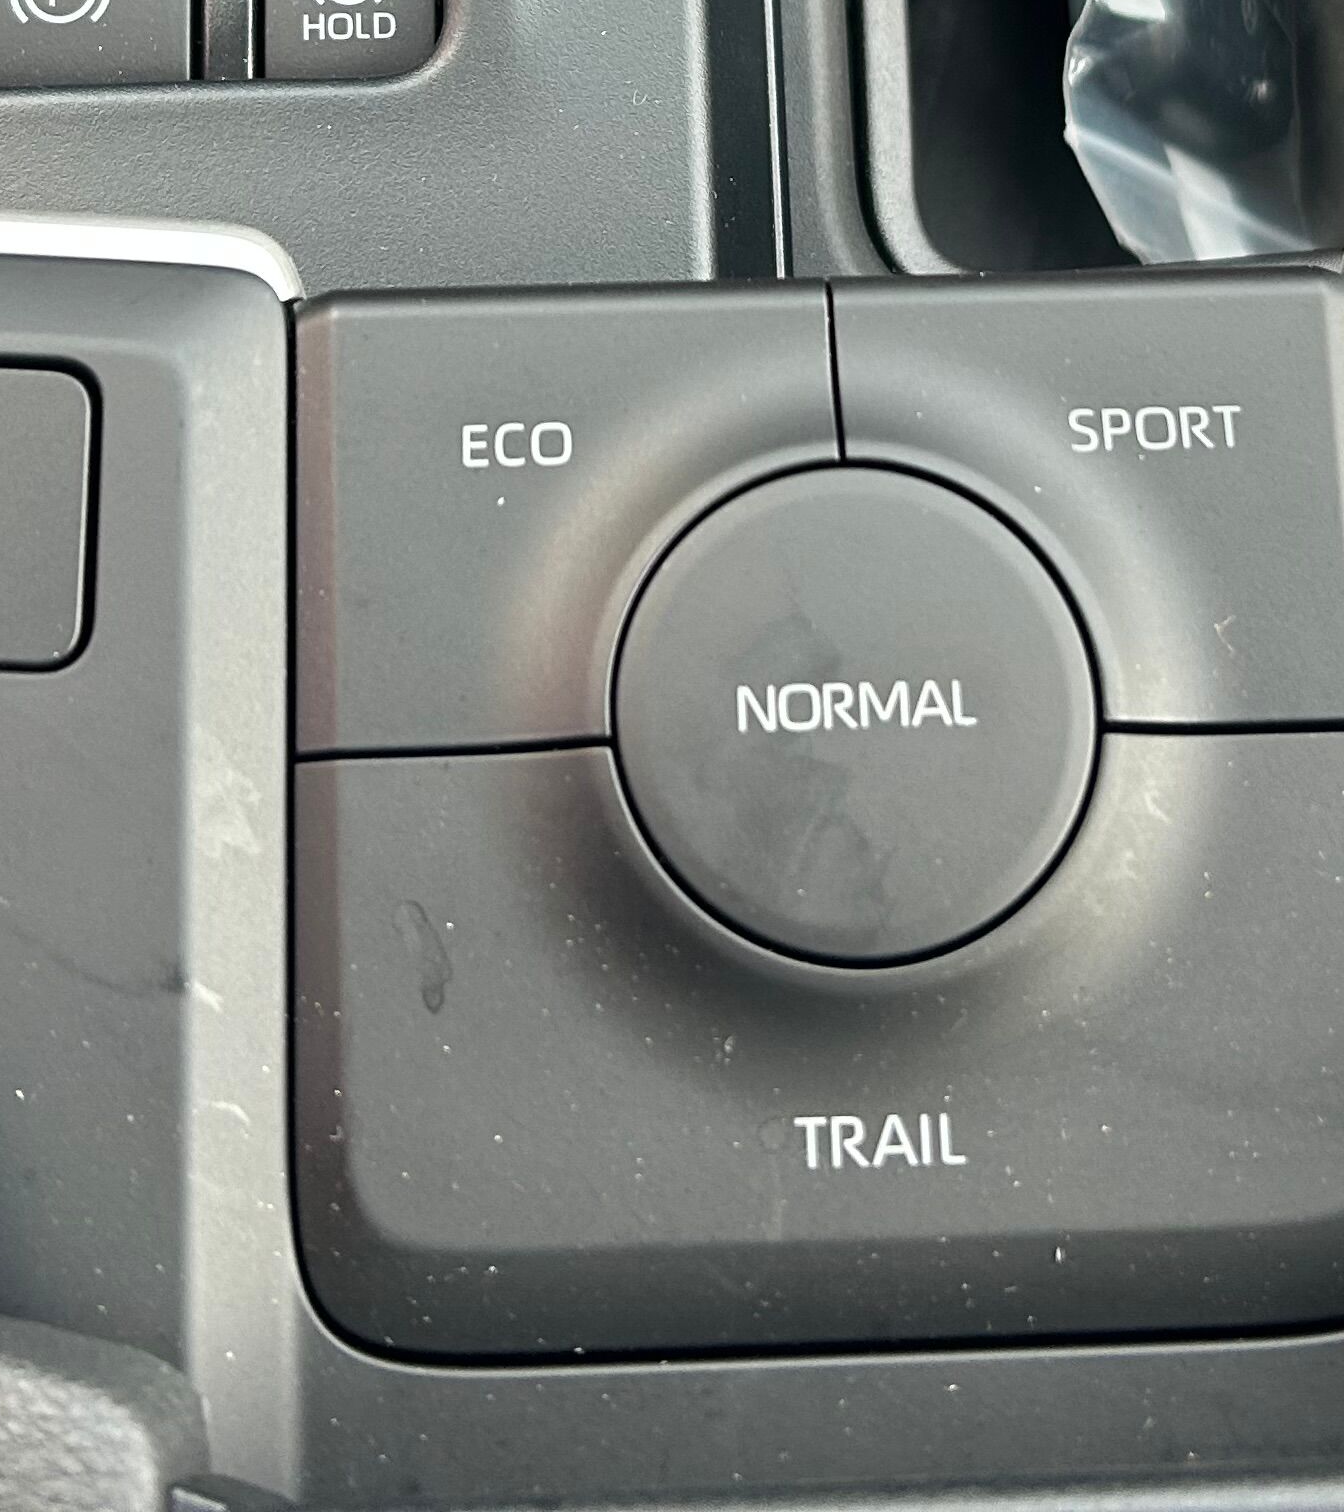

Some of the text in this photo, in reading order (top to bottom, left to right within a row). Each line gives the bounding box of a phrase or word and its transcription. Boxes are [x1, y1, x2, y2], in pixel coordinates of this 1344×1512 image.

[302, 11, 398, 42] HOLD
[459, 421, 575, 469] ECO
[1067, 404, 1243, 454] SPORT
[735, 678, 979, 734] NORMAL
[792, 1111, 970, 1171] TRAIL
